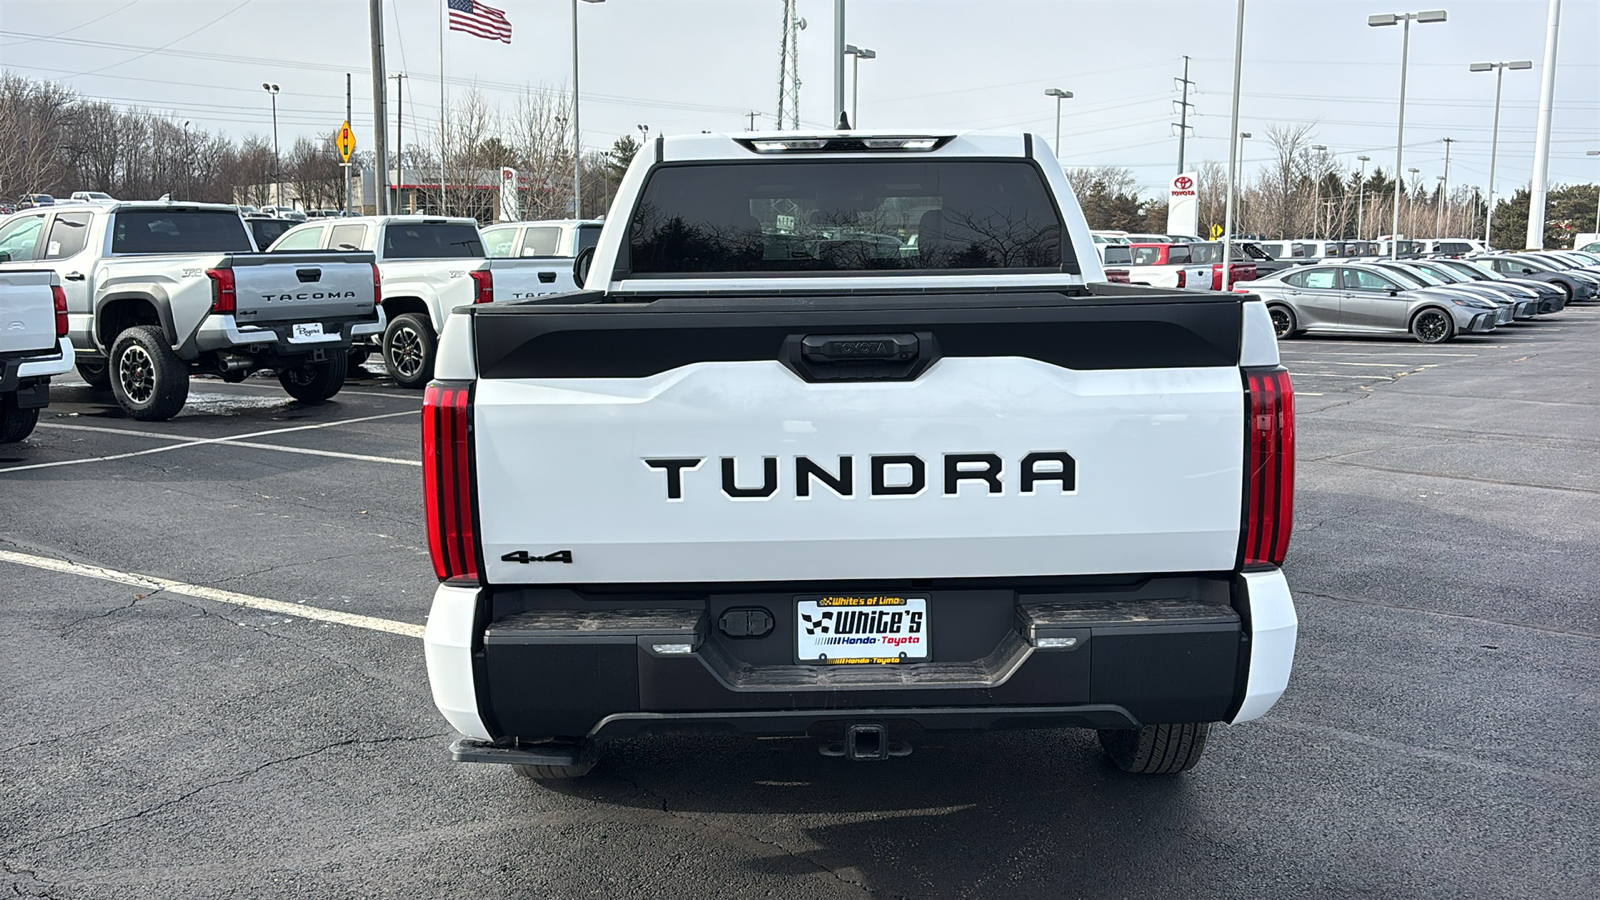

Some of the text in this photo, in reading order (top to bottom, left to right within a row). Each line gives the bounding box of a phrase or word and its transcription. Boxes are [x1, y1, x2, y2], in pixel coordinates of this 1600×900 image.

[262, 291, 356, 302] TACOMA
[834, 342, 888, 354] TOYOTA
[642, 450, 1078, 500] TUNDRA
[832, 596, 900, 606] White's of Lima
[834, 610, 923, 634] White's
[841, 636, 920, 647] Honda Toyota
[873, 657, 900, 665] Toyota
